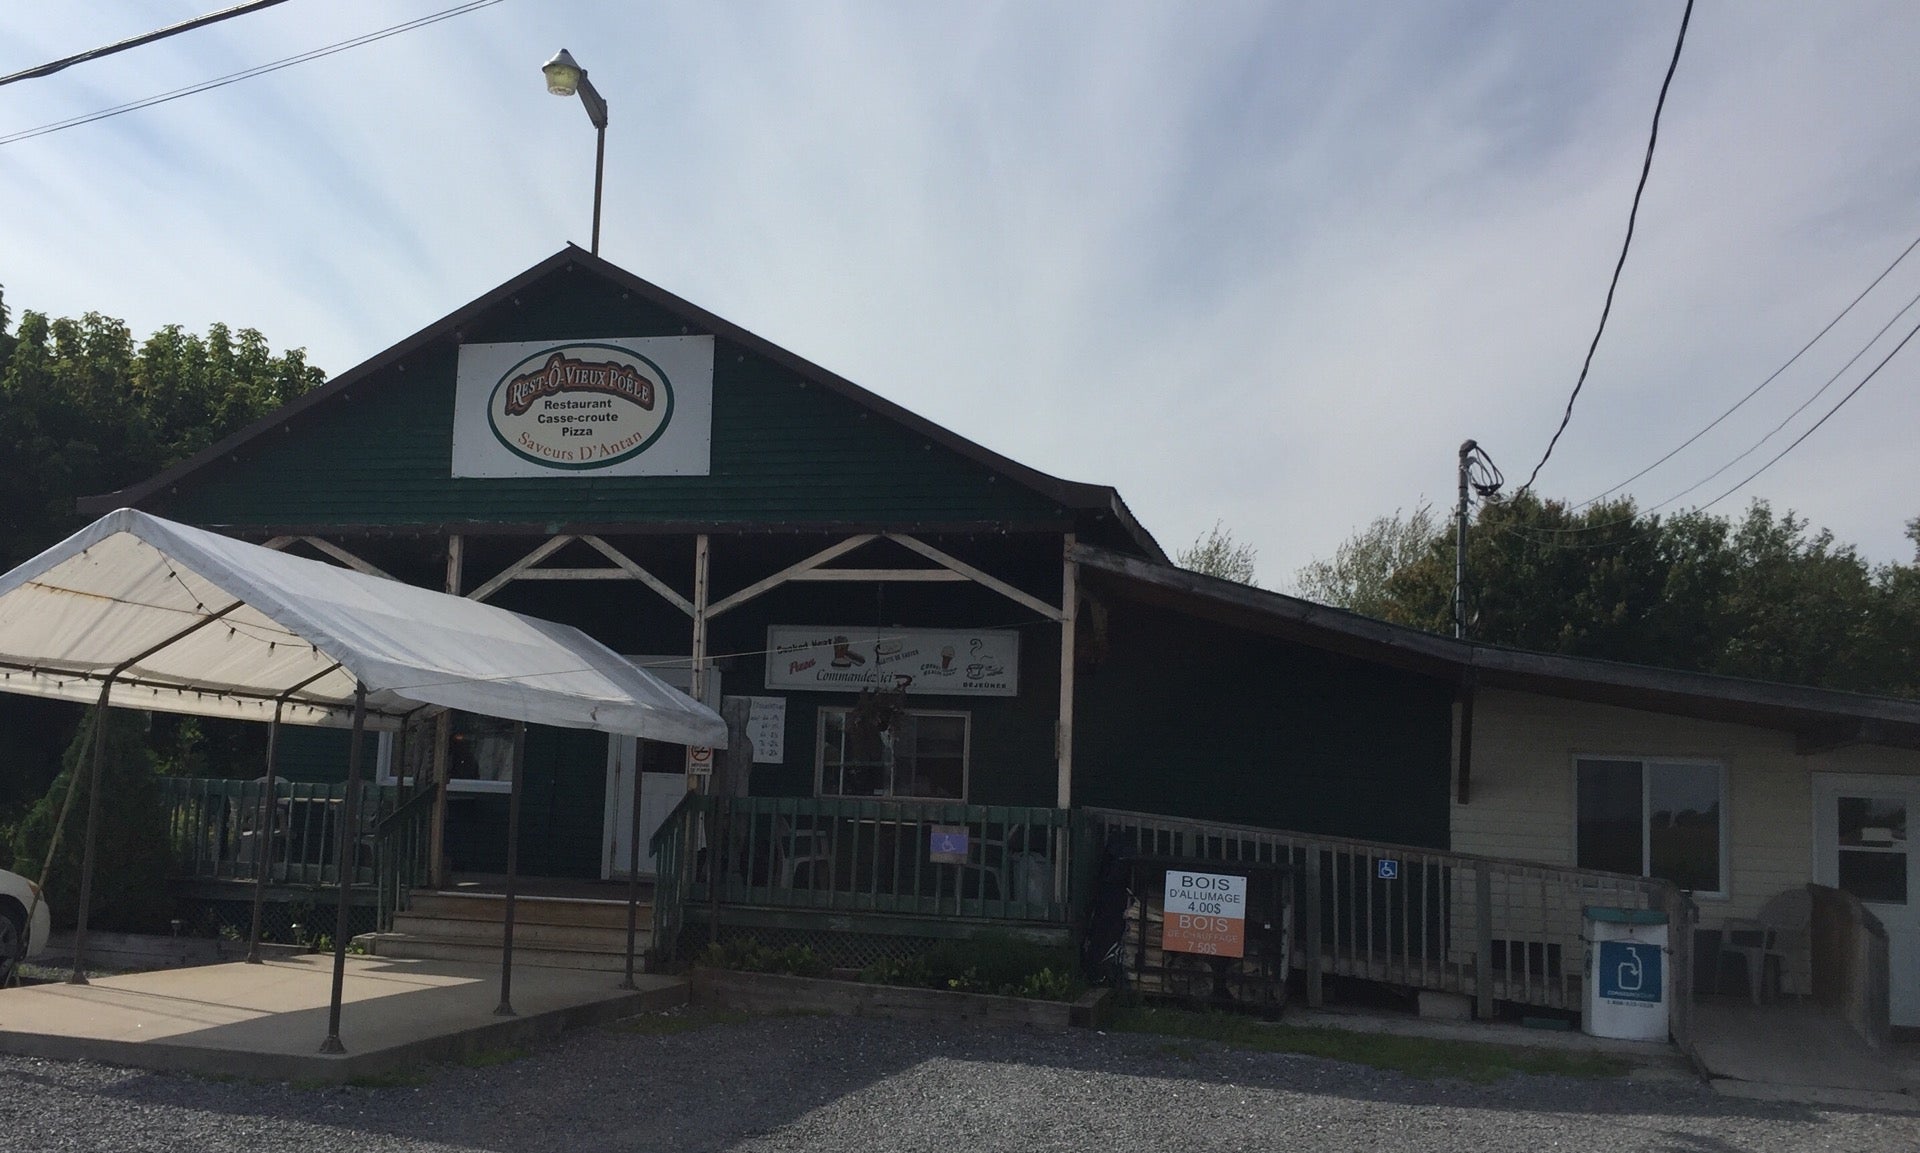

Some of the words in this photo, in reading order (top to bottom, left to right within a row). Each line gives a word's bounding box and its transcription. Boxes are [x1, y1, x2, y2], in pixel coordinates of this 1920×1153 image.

[544, 398, 612, 411] Restaurant
[537, 412, 619, 424] Casse-croute
[561, 426, 593, 437] Pizza
[517, 431, 574, 460] Saveurs
[579, 431, 643, 460] D'Antan
[1181, 875, 1230, 891] BOIS
[1169, 889, 1240, 904] D'ALLUMAGE
[1188, 901, 1222, 915] 4.00$
[1178, 914, 1229, 933] BOIS
